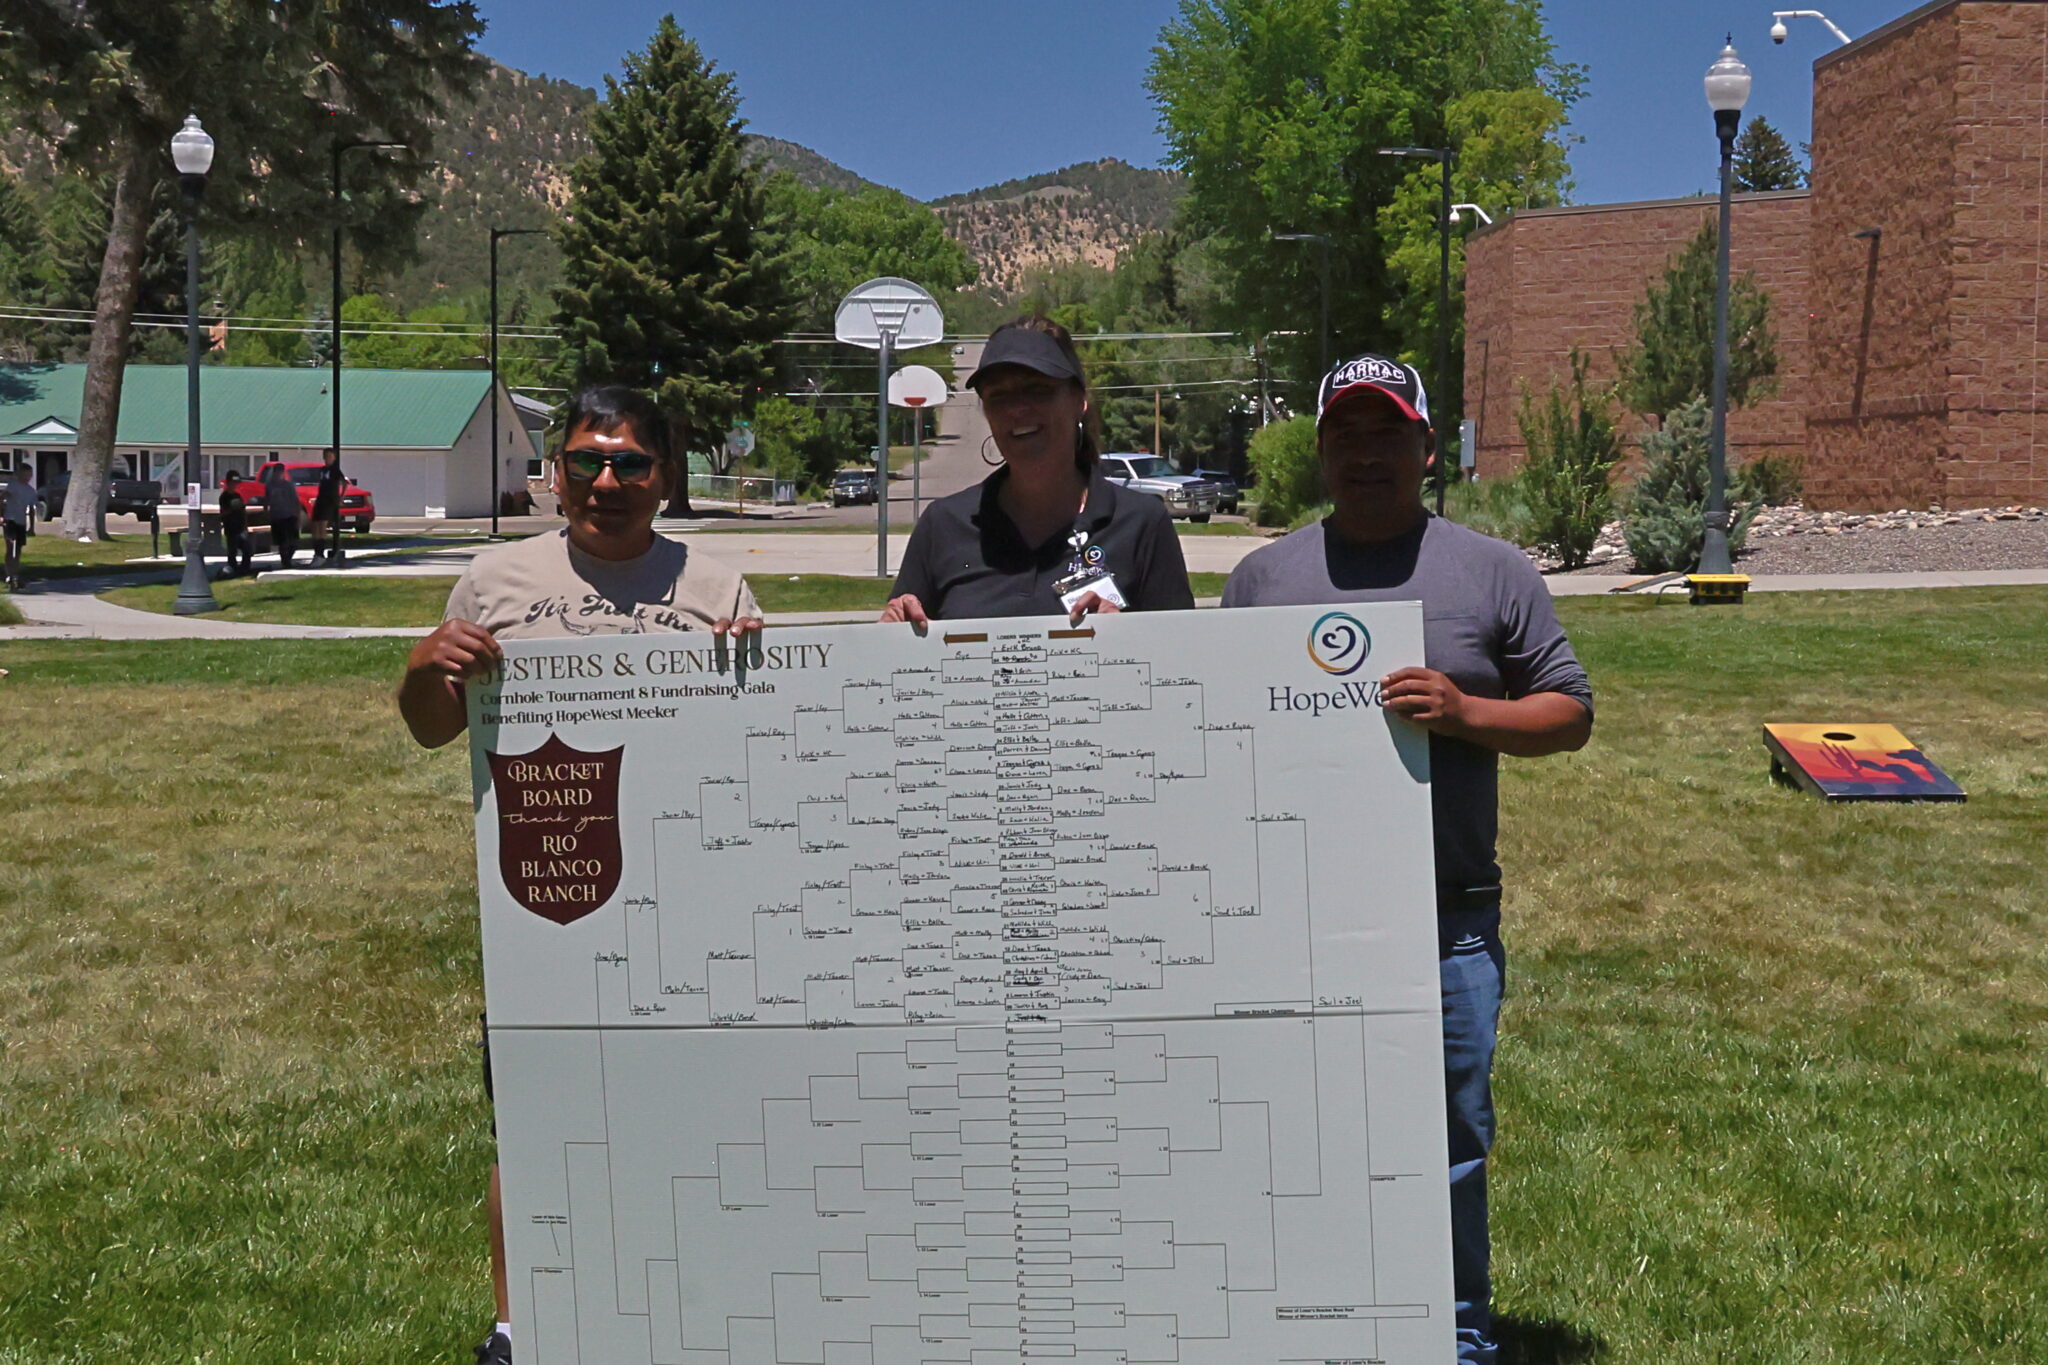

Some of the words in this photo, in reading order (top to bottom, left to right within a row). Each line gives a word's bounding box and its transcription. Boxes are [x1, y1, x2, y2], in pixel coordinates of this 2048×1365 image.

[1335, 362, 1403, 383] HARMAC
[613, 652, 636, 677] &
[646, 643, 833, 675] GENEROSITY
[480, 690, 544, 706] Cornhole
[546, 687, 635, 703] Tournament
[638, 687, 649, 698] &
[651, 683, 739, 700] Fundraising
[741, 681, 776, 695] Gala
[1268, 682, 1383, 717] HopeWe
[481, 711, 553, 728] Benefiting
[556, 707, 624, 725] HopeWest
[626, 706, 679, 719] Meeker
[507, 760, 604, 783] BRACKET
[522, 788, 593, 807] BOARD
[574, 815, 614, 833] you
[542, 835, 577, 856] RIO
[521, 859, 602, 878] BLANCO
[528, 884, 597, 903] RANCH
